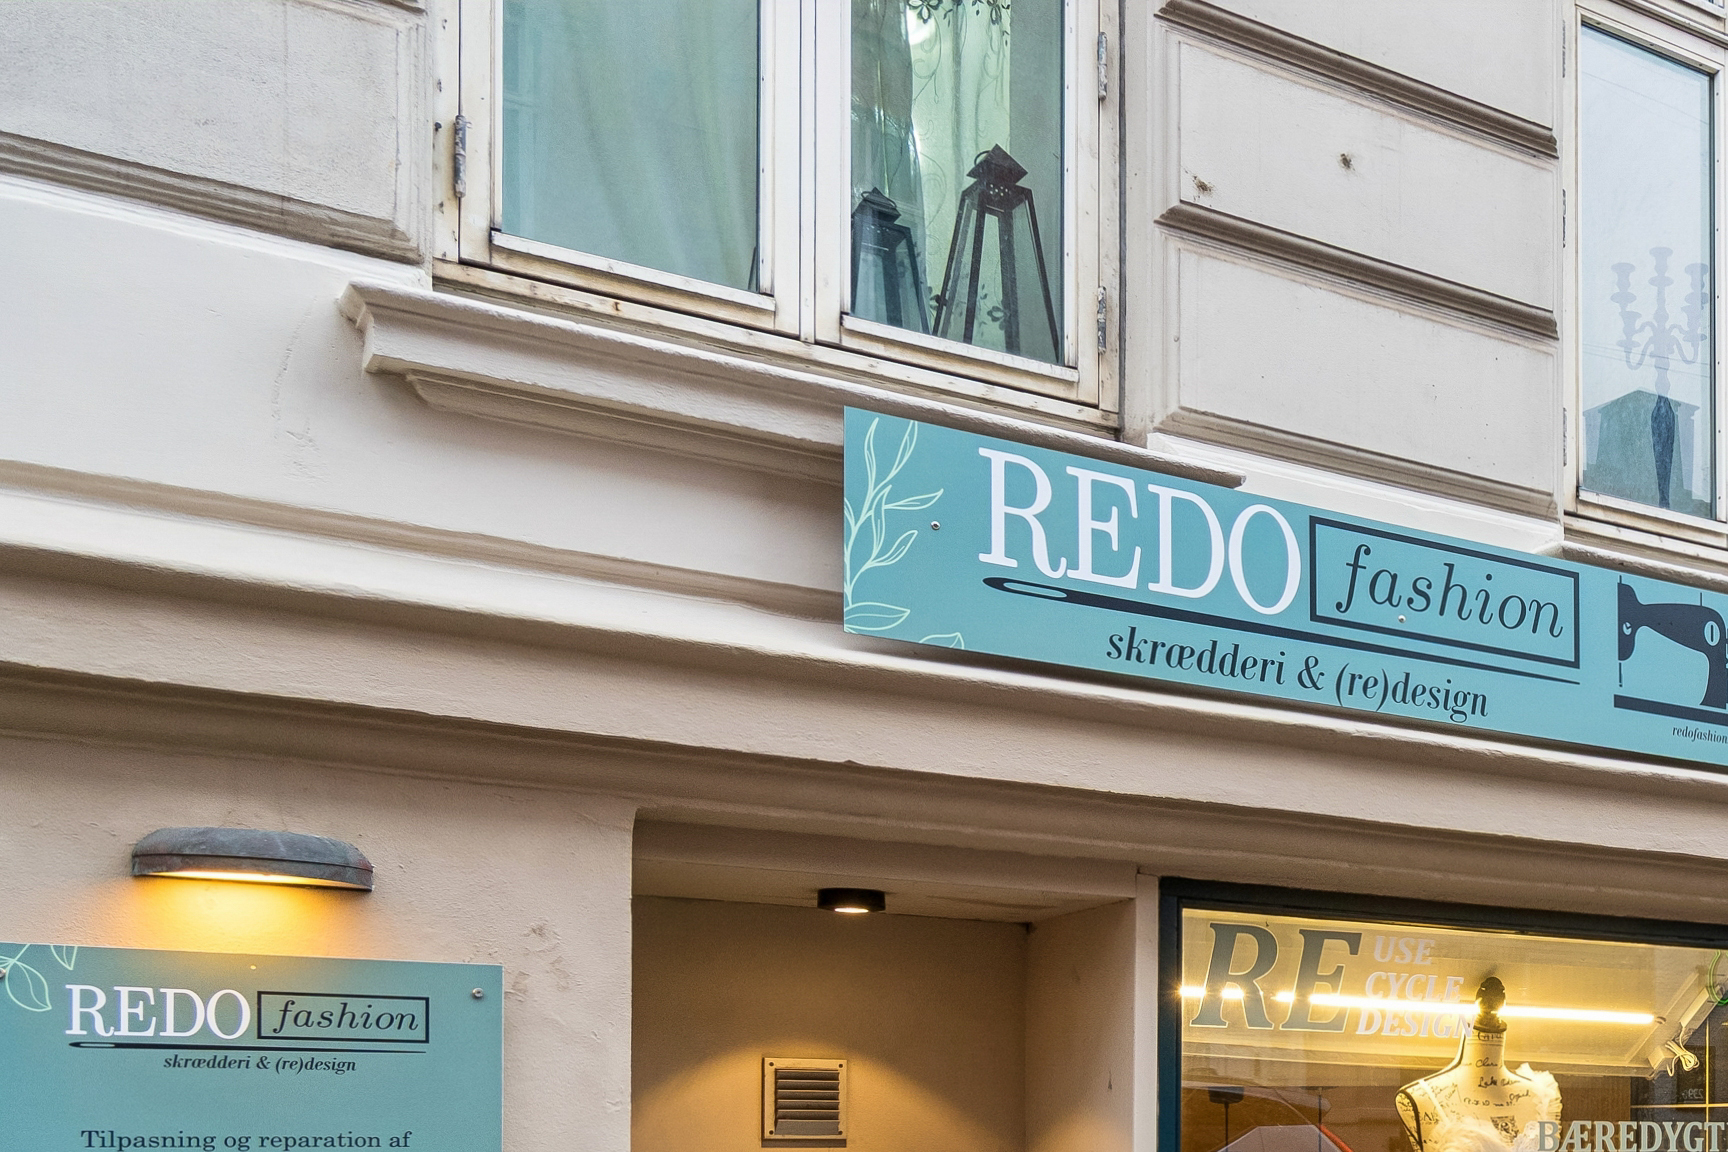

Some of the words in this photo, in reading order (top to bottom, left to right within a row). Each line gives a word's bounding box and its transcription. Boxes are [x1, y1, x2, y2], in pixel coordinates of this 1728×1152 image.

[977, 446, 1303, 615] REDO
[1335, 543, 1565, 639] fashion
[1107, 626, 1284, 689] skrædderi
[1298, 657, 1325, 692] &
[1334, 661, 1488, 723] (re)design
[1373, 935, 1435, 965] USE
[1190, 922, 1363, 1032] RE
[1366, 972, 1464, 1002] CYCLE
[65, 983, 251, 1040] REDO
[272, 999, 419, 1034] fashion
[1356, 1009, 1475, 1038] DESIGN
[163, 1054, 251, 1071] skrædderi
[256, 1056, 271, 1070] &
[275, 1056, 357, 1075] (re)design
[81, 1130, 216, 1152] Tilpasning
[224, 1133, 251, 1152] og
[259, 1132, 382, 1151] reparation
[389, 1130, 412, 1148] af
